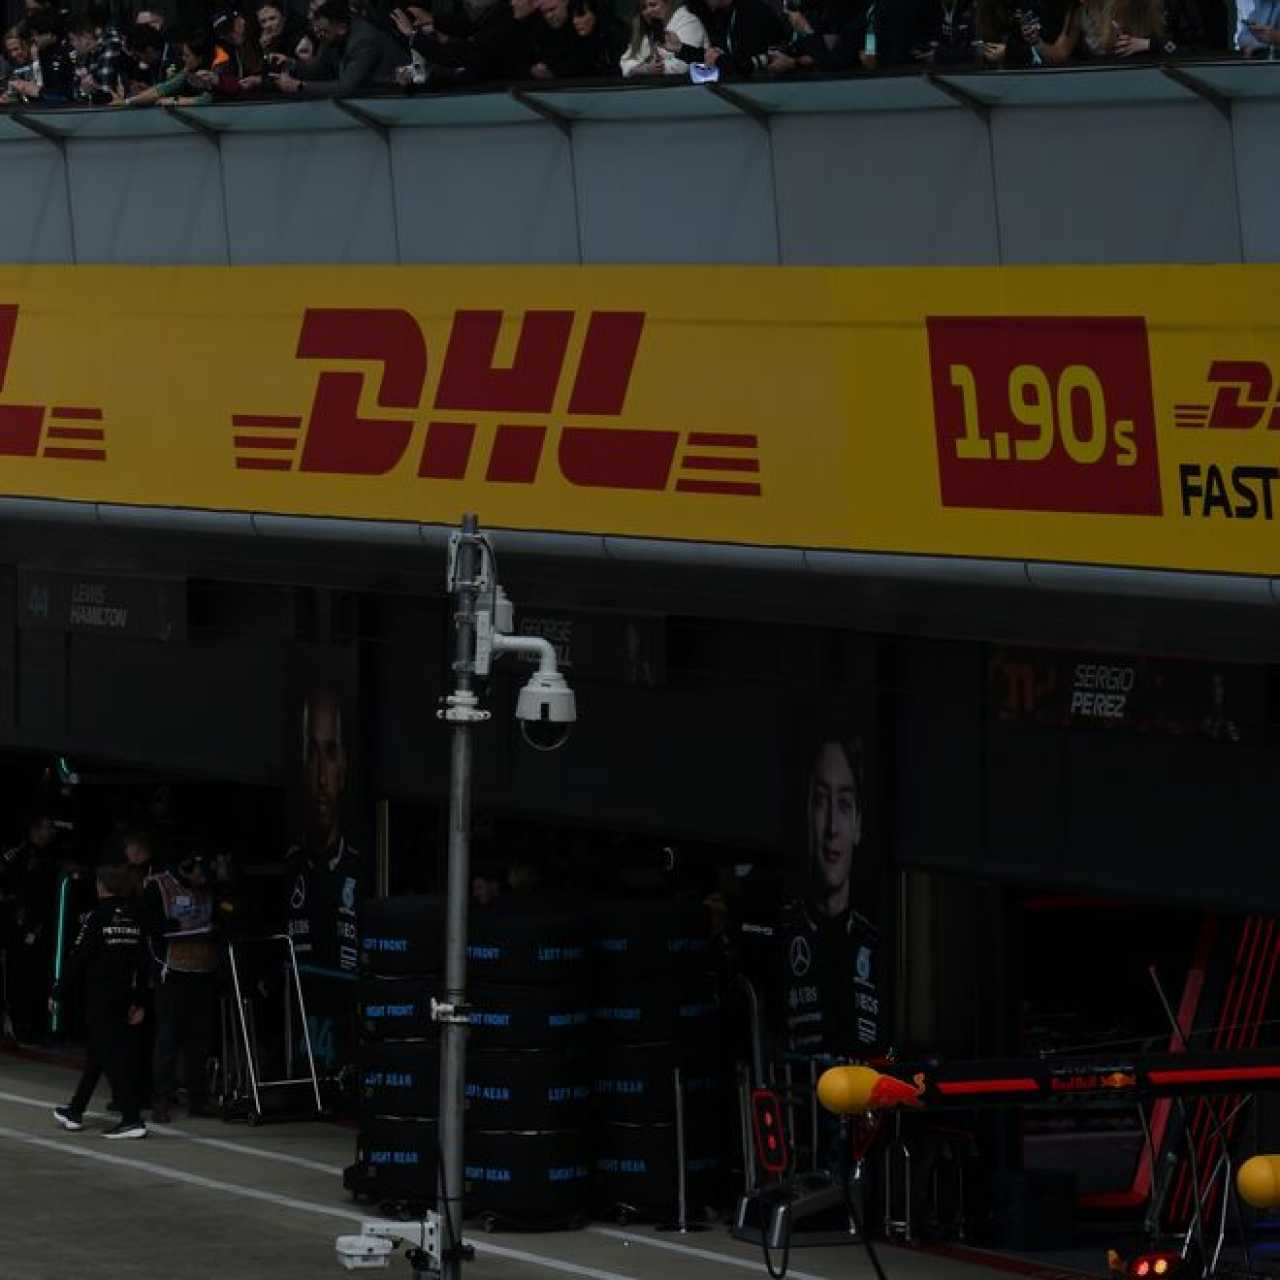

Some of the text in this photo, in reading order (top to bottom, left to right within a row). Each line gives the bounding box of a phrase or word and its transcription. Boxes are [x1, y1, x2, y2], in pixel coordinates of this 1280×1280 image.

[294, 307, 680, 492] DHL
[1072, 663, 1135, 692] SERGIO
[1071, 691, 1128, 719] PEREZ
